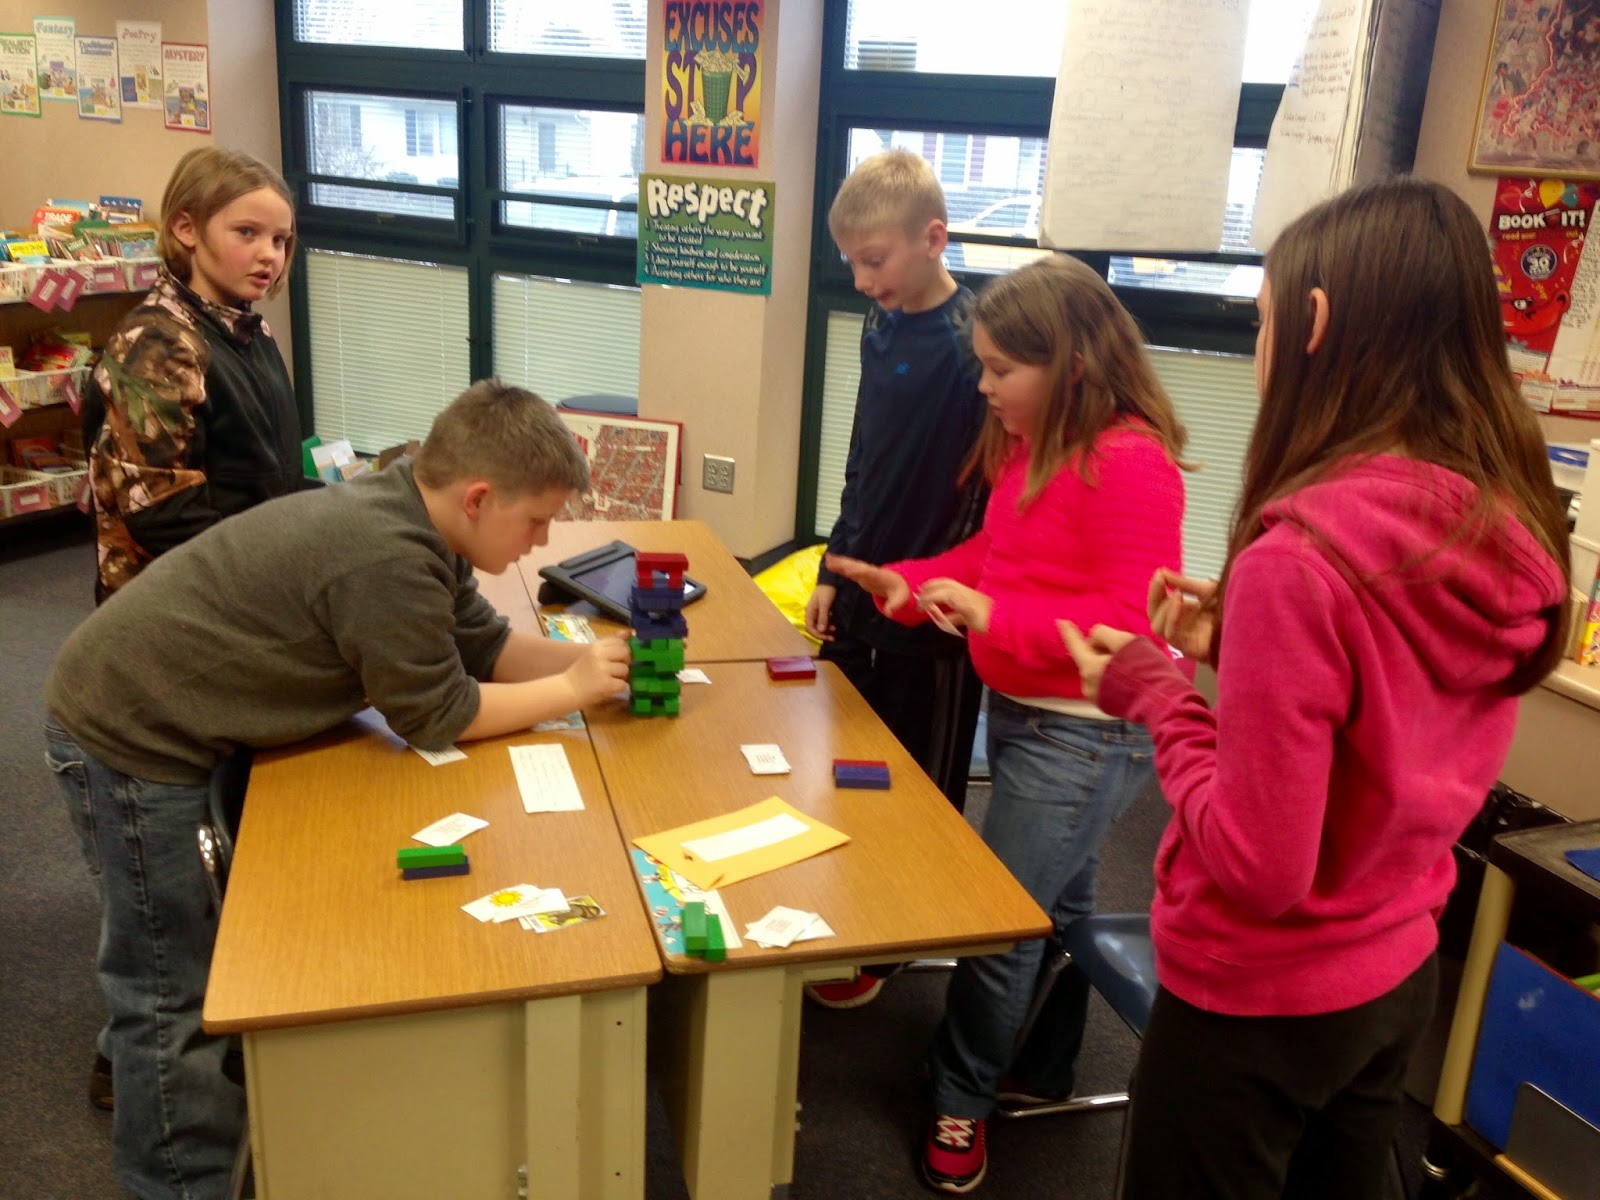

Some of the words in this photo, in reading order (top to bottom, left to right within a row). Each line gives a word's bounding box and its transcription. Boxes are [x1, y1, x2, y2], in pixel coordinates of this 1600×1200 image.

[122, 28, 157, 42] Poetry
[664, 2, 760, 53] EXCUSES
[164, 49, 205, 62] MYSTERY
[665, 50, 757, 121] STP
[665, 118, 754, 165] HERE
[647, 179, 766, 228] Respect
[1498, 211, 1547, 231] BOOK
[1561, 209, 1586, 228] IT!
